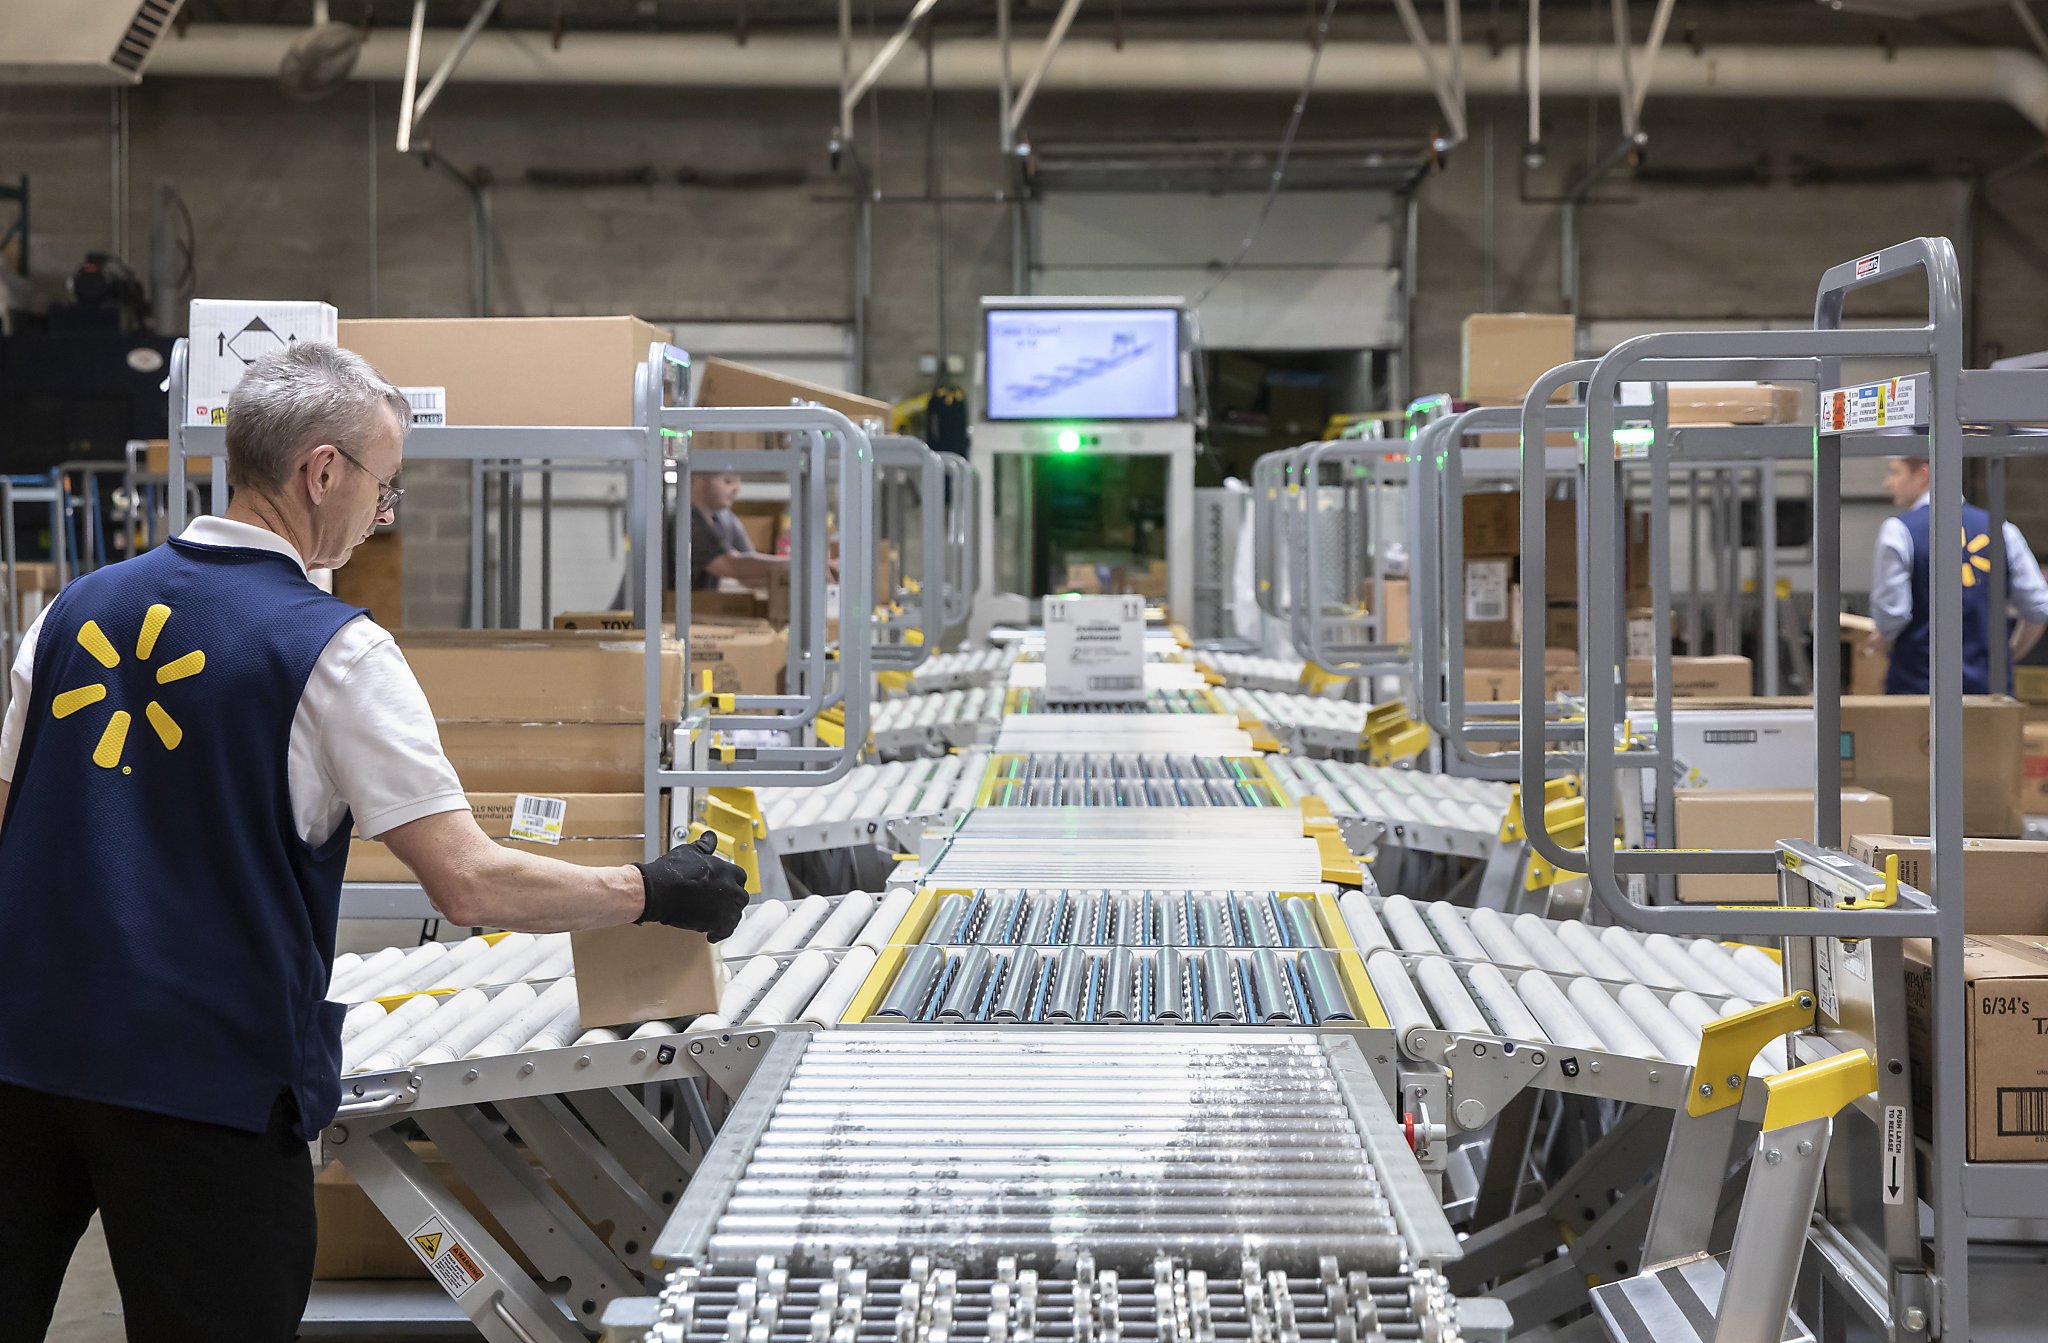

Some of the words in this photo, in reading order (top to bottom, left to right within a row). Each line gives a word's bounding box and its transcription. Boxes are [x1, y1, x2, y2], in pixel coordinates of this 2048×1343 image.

[601, 621, 634, 630] TOY
[1982, 997, 2029, 1014] 6/34's
[1888, 1109, 1895, 1119] TO
[456, 1250, 481, 1279] WARNING
